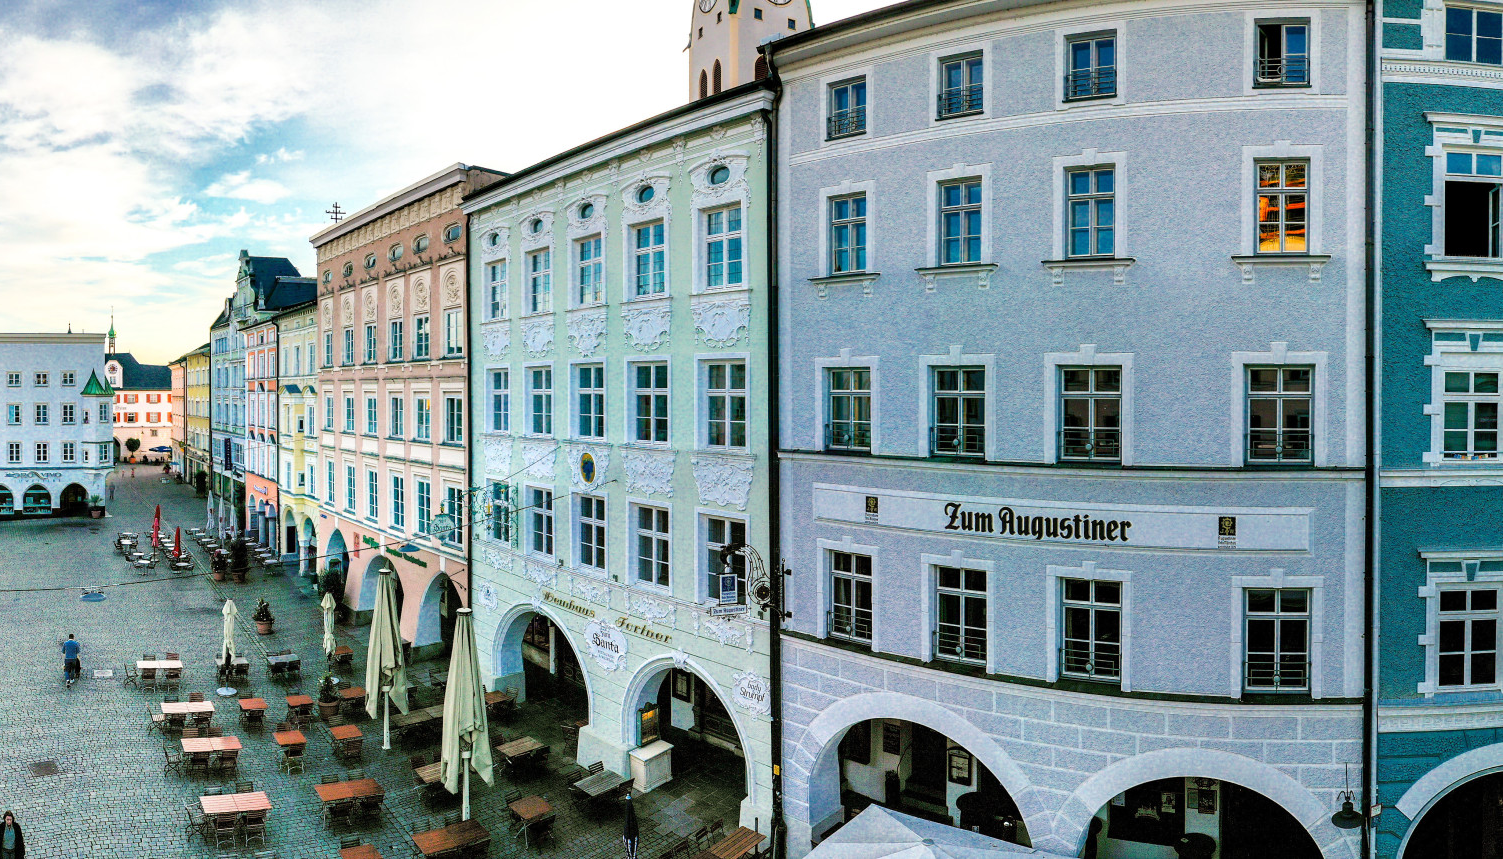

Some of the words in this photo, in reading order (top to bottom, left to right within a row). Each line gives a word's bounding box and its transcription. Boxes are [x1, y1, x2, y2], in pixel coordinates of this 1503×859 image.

[944, 502, 994, 534] Zum
[998, 506, 1132, 542] Augustiner
[542, 590, 596, 619] Weinhaus
[591, 632, 620, 654] Santa
